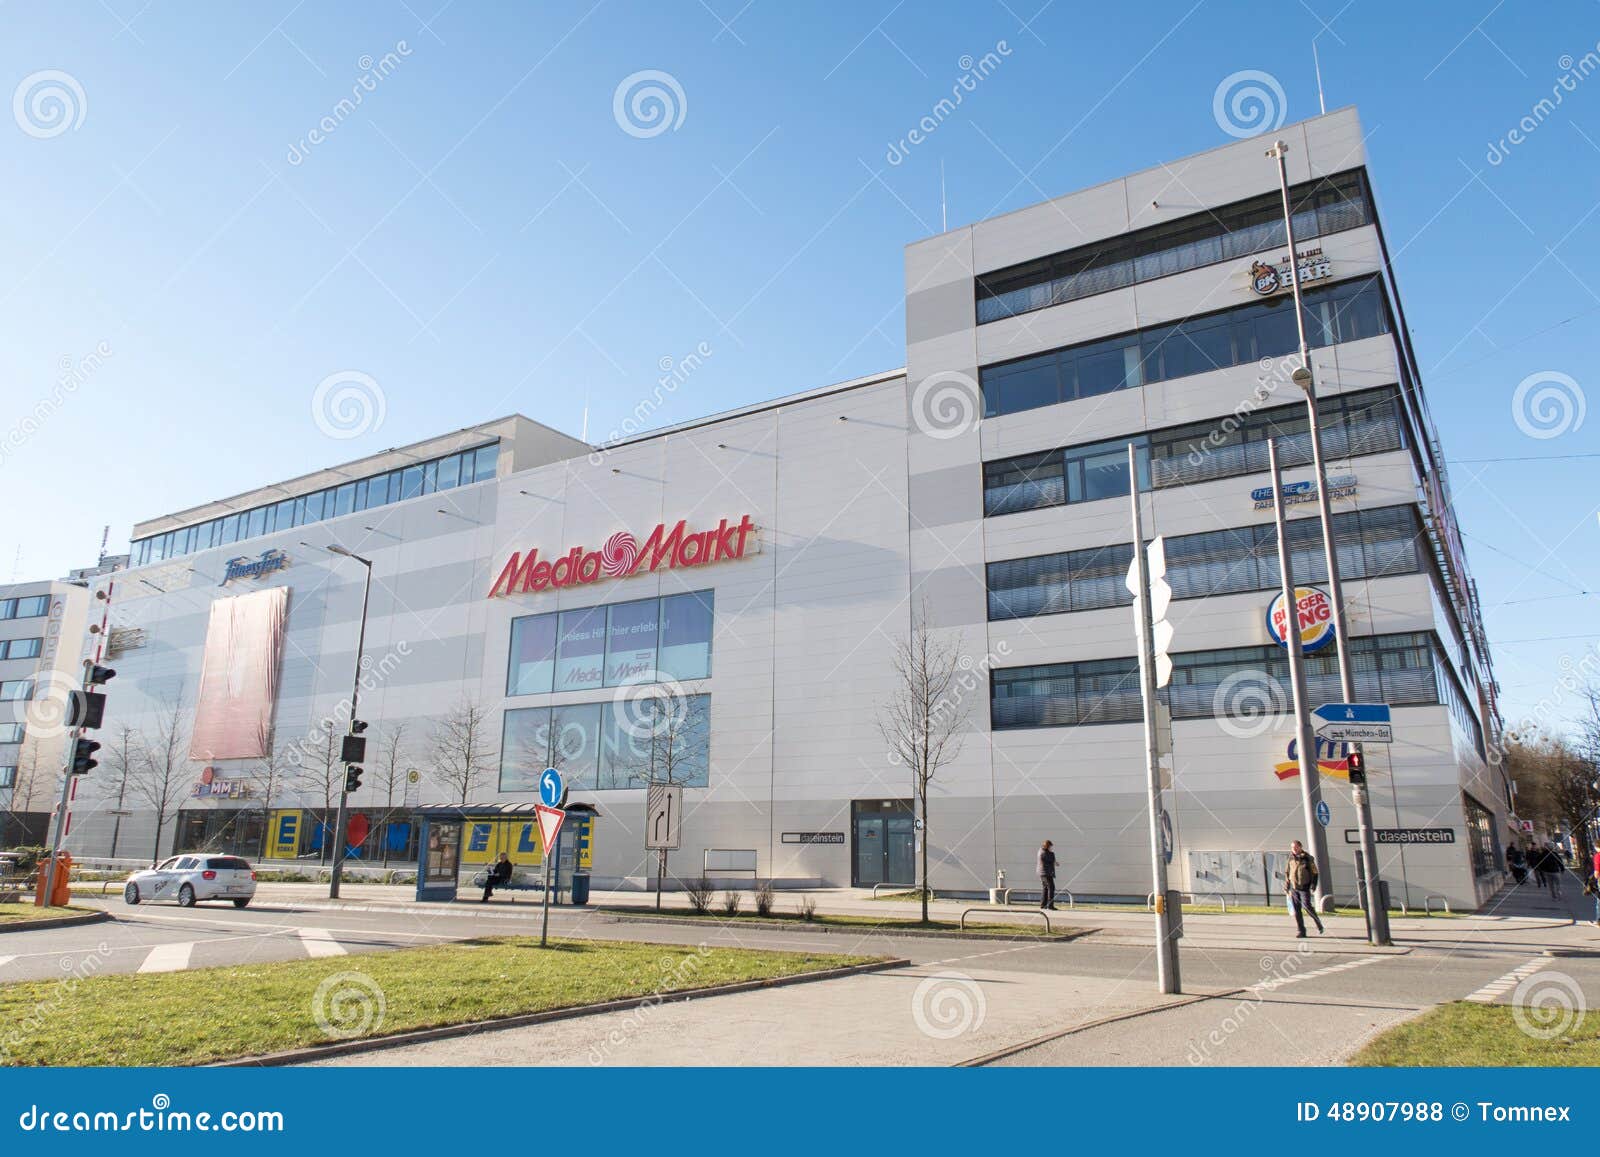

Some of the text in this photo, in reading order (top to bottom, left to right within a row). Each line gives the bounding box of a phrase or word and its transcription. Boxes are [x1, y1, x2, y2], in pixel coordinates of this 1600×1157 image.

[1273, 593, 1326, 624] BGER
[1278, 603, 1330, 641] KNG
[1380, 831, 1453, 842] daseinstein
